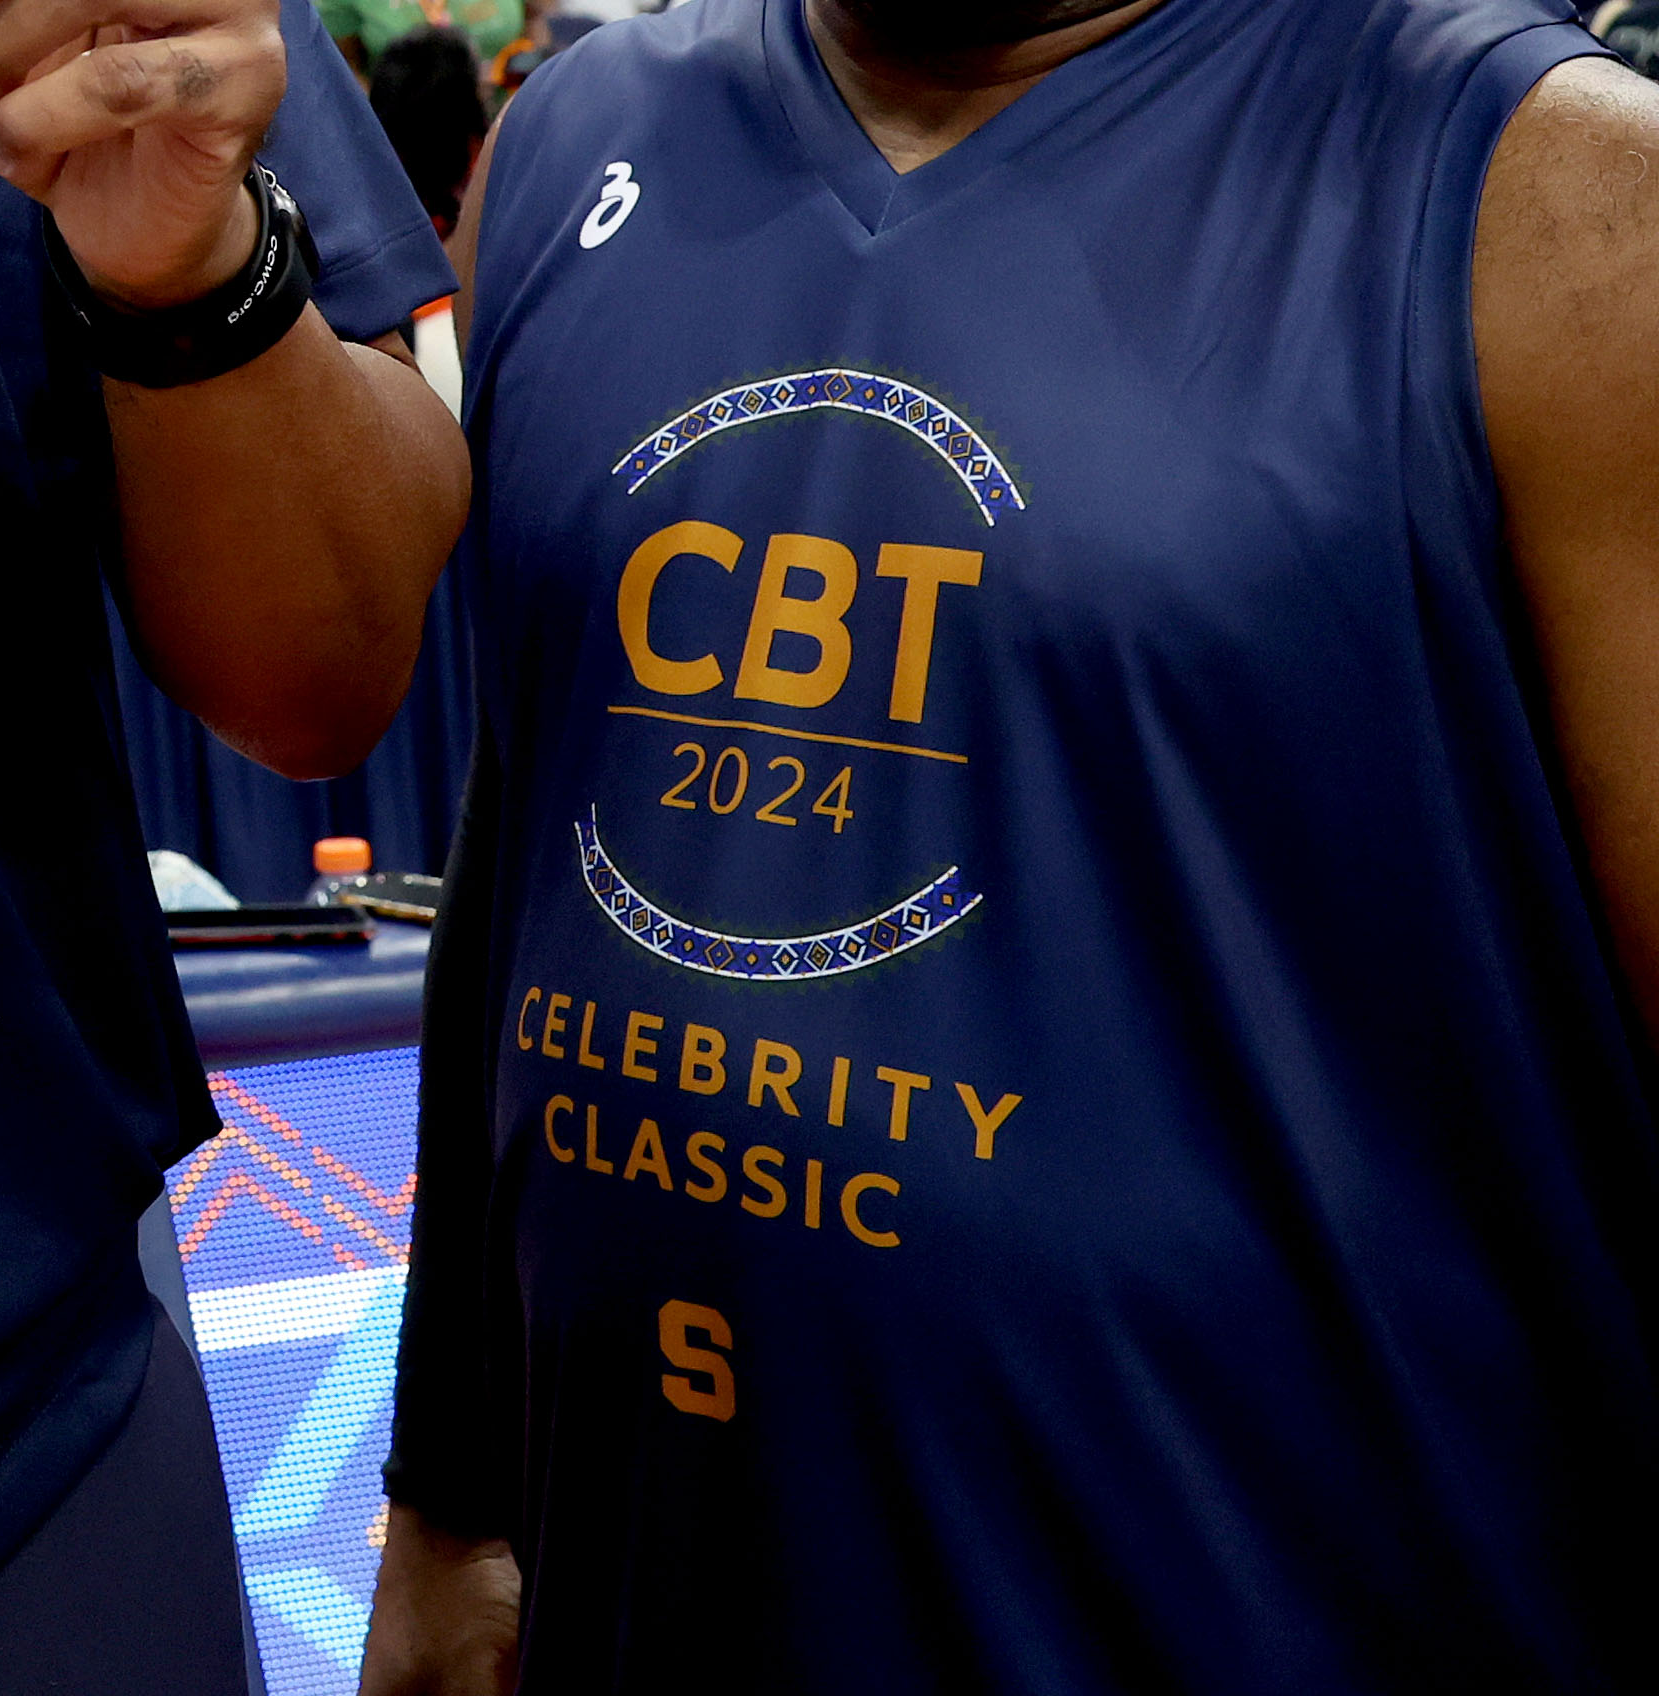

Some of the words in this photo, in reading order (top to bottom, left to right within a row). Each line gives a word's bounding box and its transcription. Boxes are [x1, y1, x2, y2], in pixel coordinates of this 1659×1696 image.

[616, 519, 984, 724] CBT
[660, 742, 854, 834] 2024
[517, 986, 1023, 1160] CELEBRITY
[544, 1094, 901, 1248] CLASSIC
[658, 1298, 736, 1423] S
